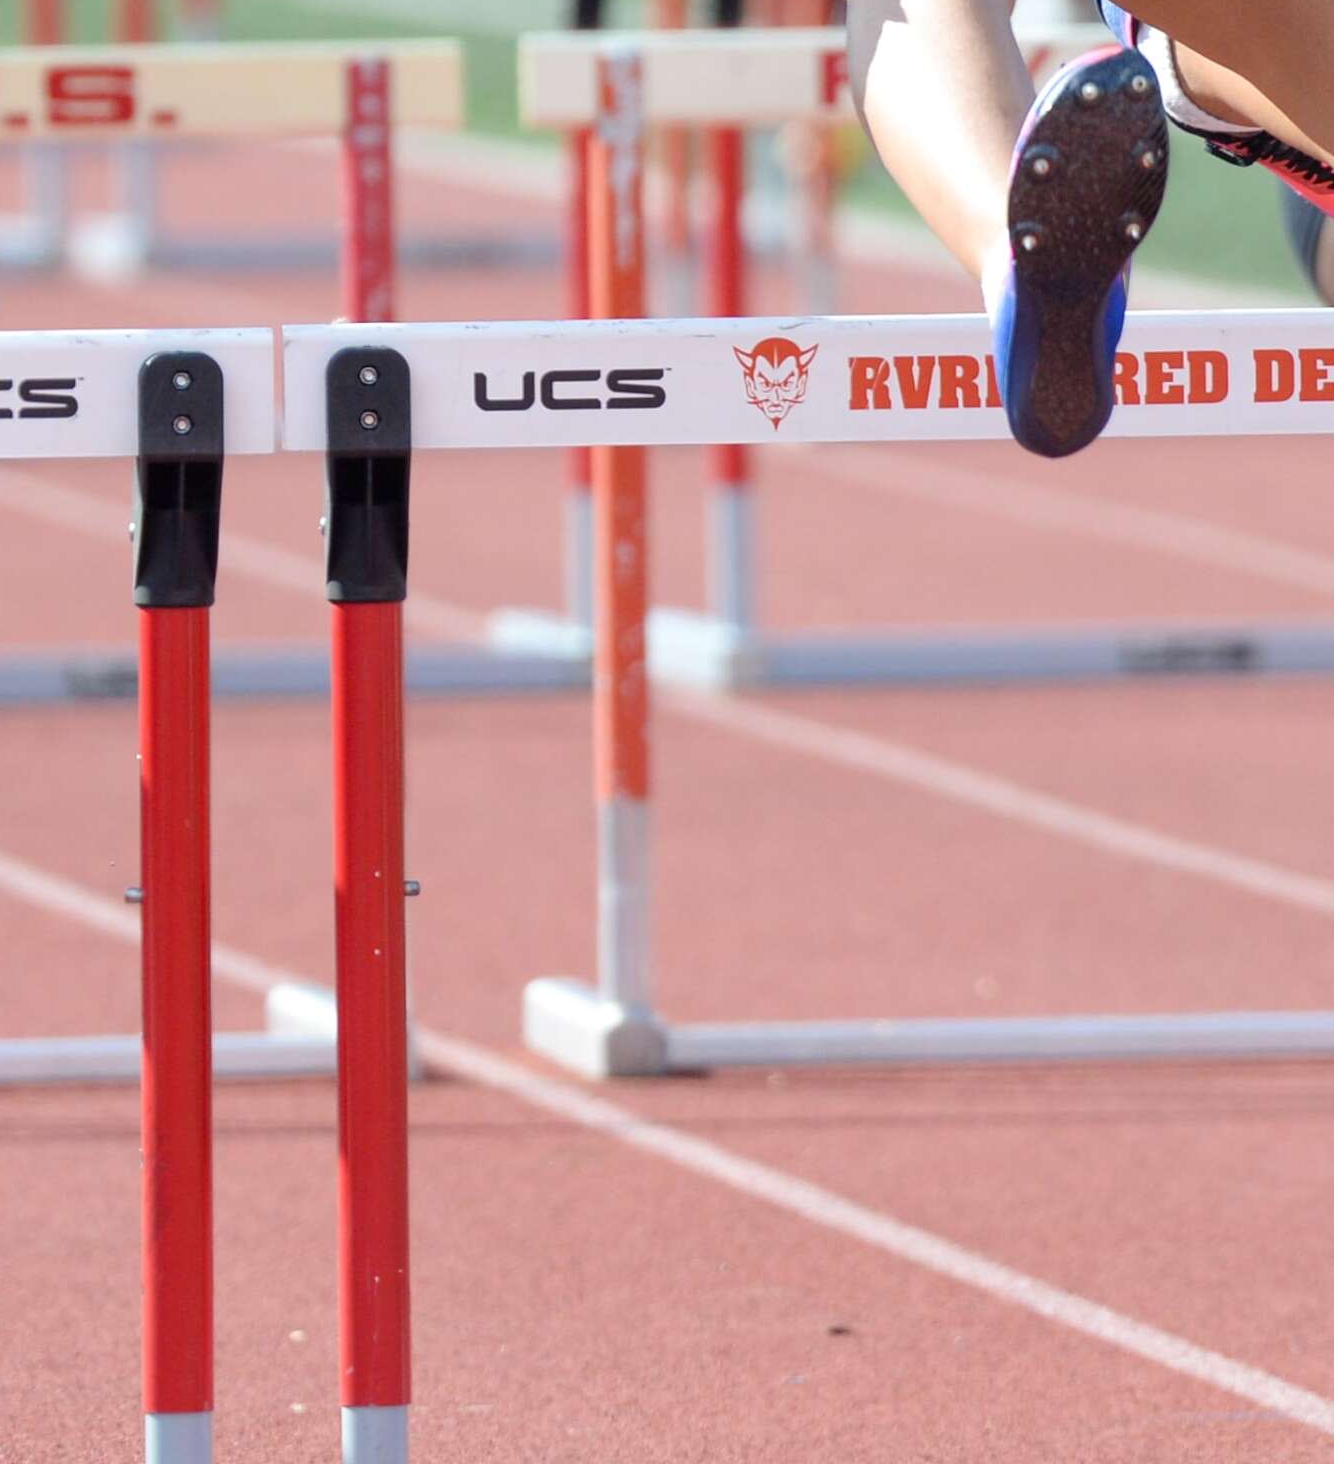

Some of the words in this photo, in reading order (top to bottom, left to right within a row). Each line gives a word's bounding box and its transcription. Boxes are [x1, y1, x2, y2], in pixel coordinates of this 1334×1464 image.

[473, 368, 667, 412] UCS
[847, 355, 1003, 410] RVR
[1112, 350, 1229, 405] RED
